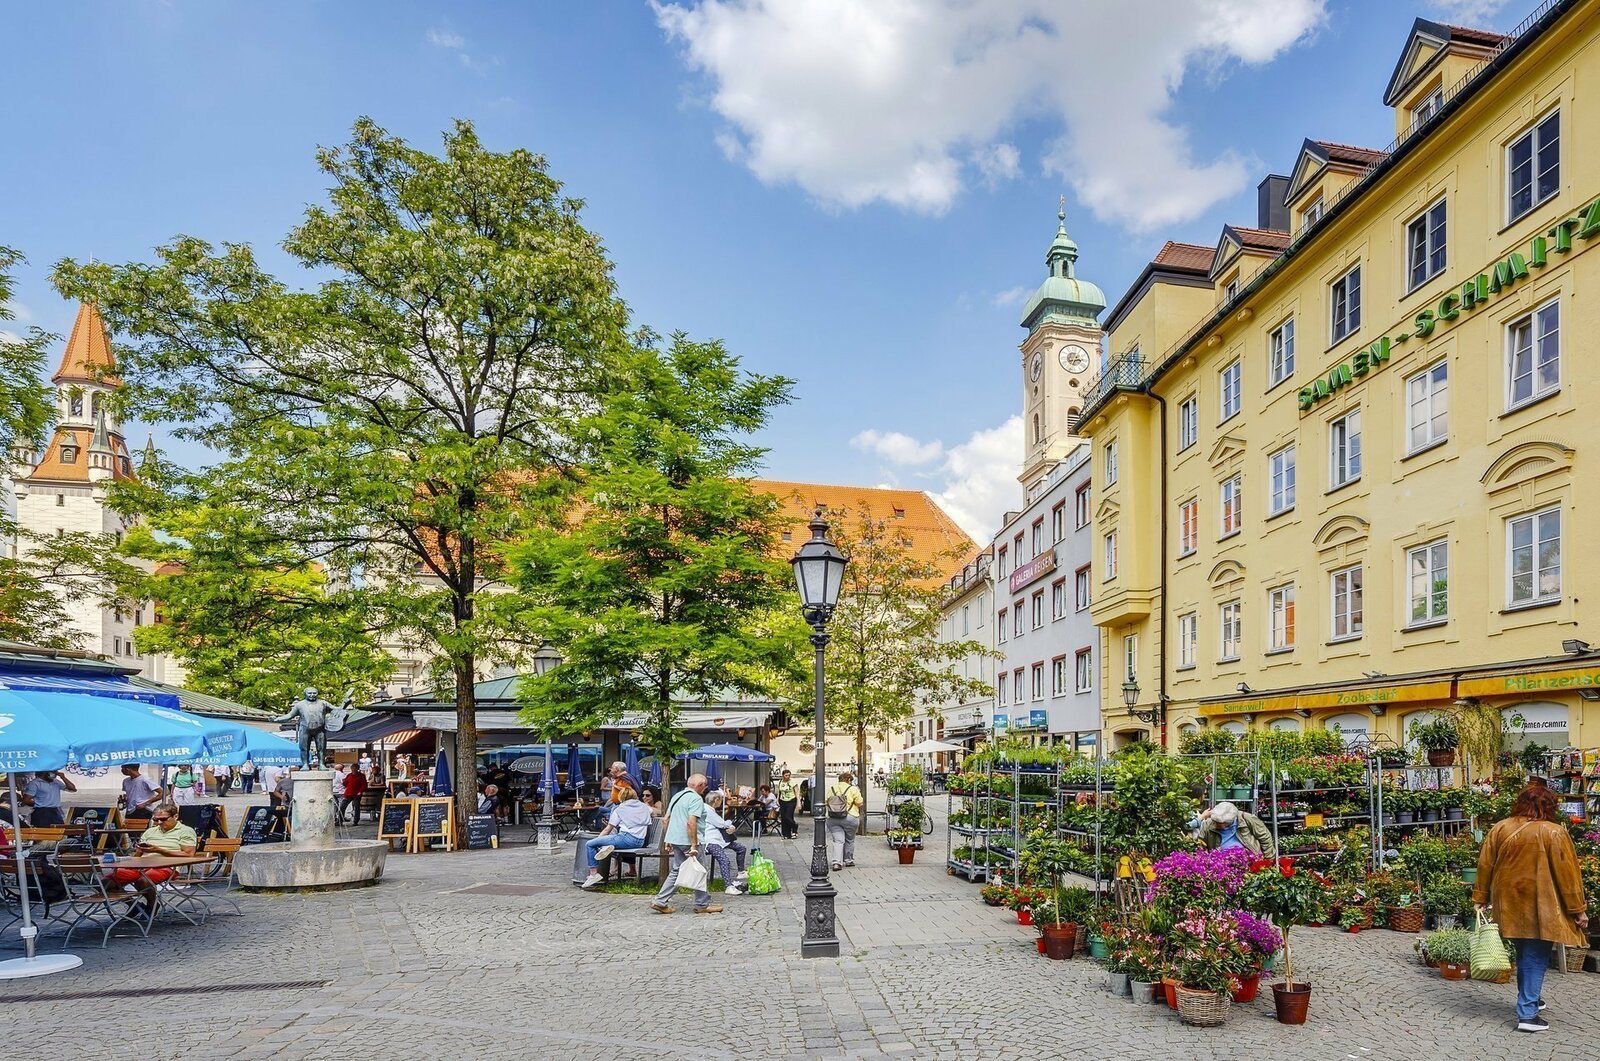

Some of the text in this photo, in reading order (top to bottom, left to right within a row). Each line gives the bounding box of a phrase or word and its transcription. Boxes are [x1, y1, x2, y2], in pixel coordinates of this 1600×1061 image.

[1337, 688, 1397, 704] Zoobedarf
[1223, 702, 1265, 713] Samenwelt
[85, 752, 109, 763] DAS
[110, 750, 136, 760] BIER
[137, 747, 161, 758] FÜR
[162, 746, 191, 757] HIER
